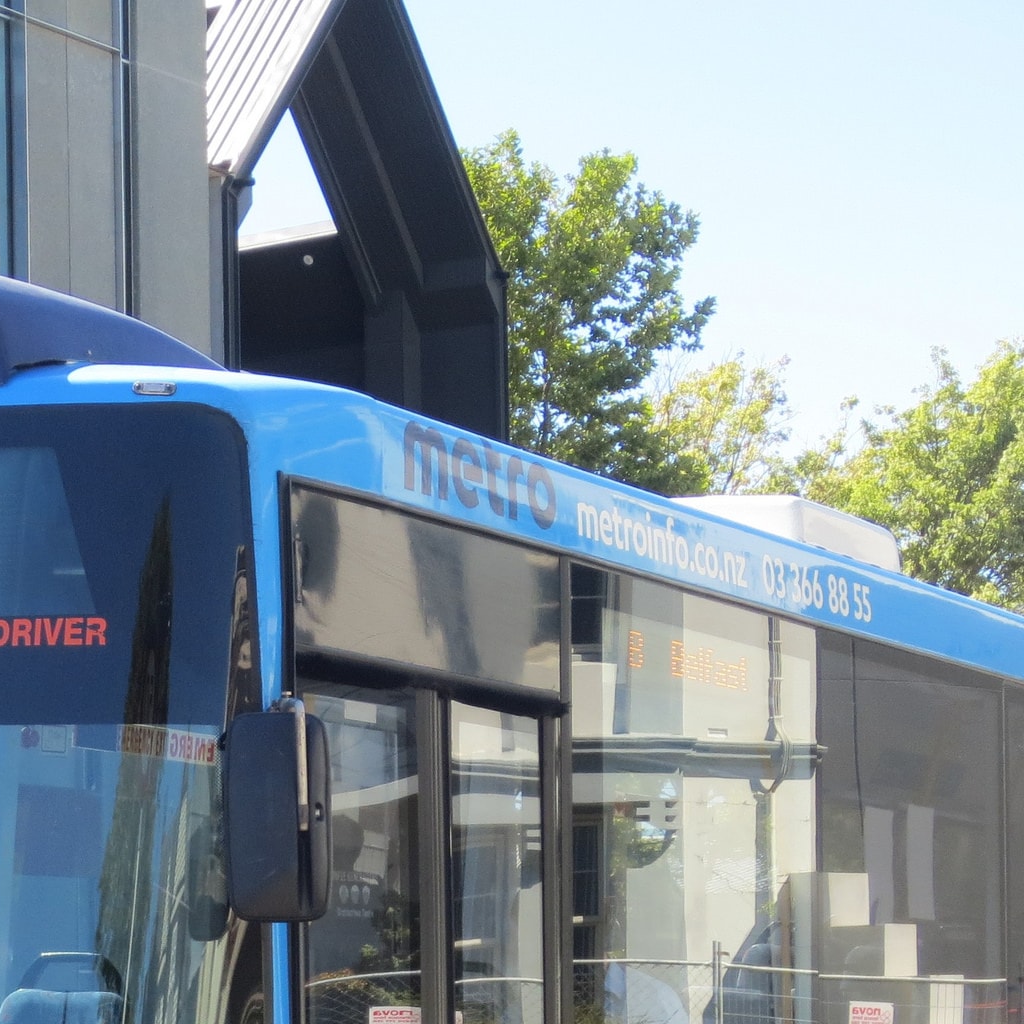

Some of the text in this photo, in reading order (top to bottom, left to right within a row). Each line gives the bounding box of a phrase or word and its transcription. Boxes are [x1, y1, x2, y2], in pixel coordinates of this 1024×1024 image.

[404, 420, 557, 530] metro
[577, 502, 872, 623] metroinfo.co.nz 03 366 88 55
